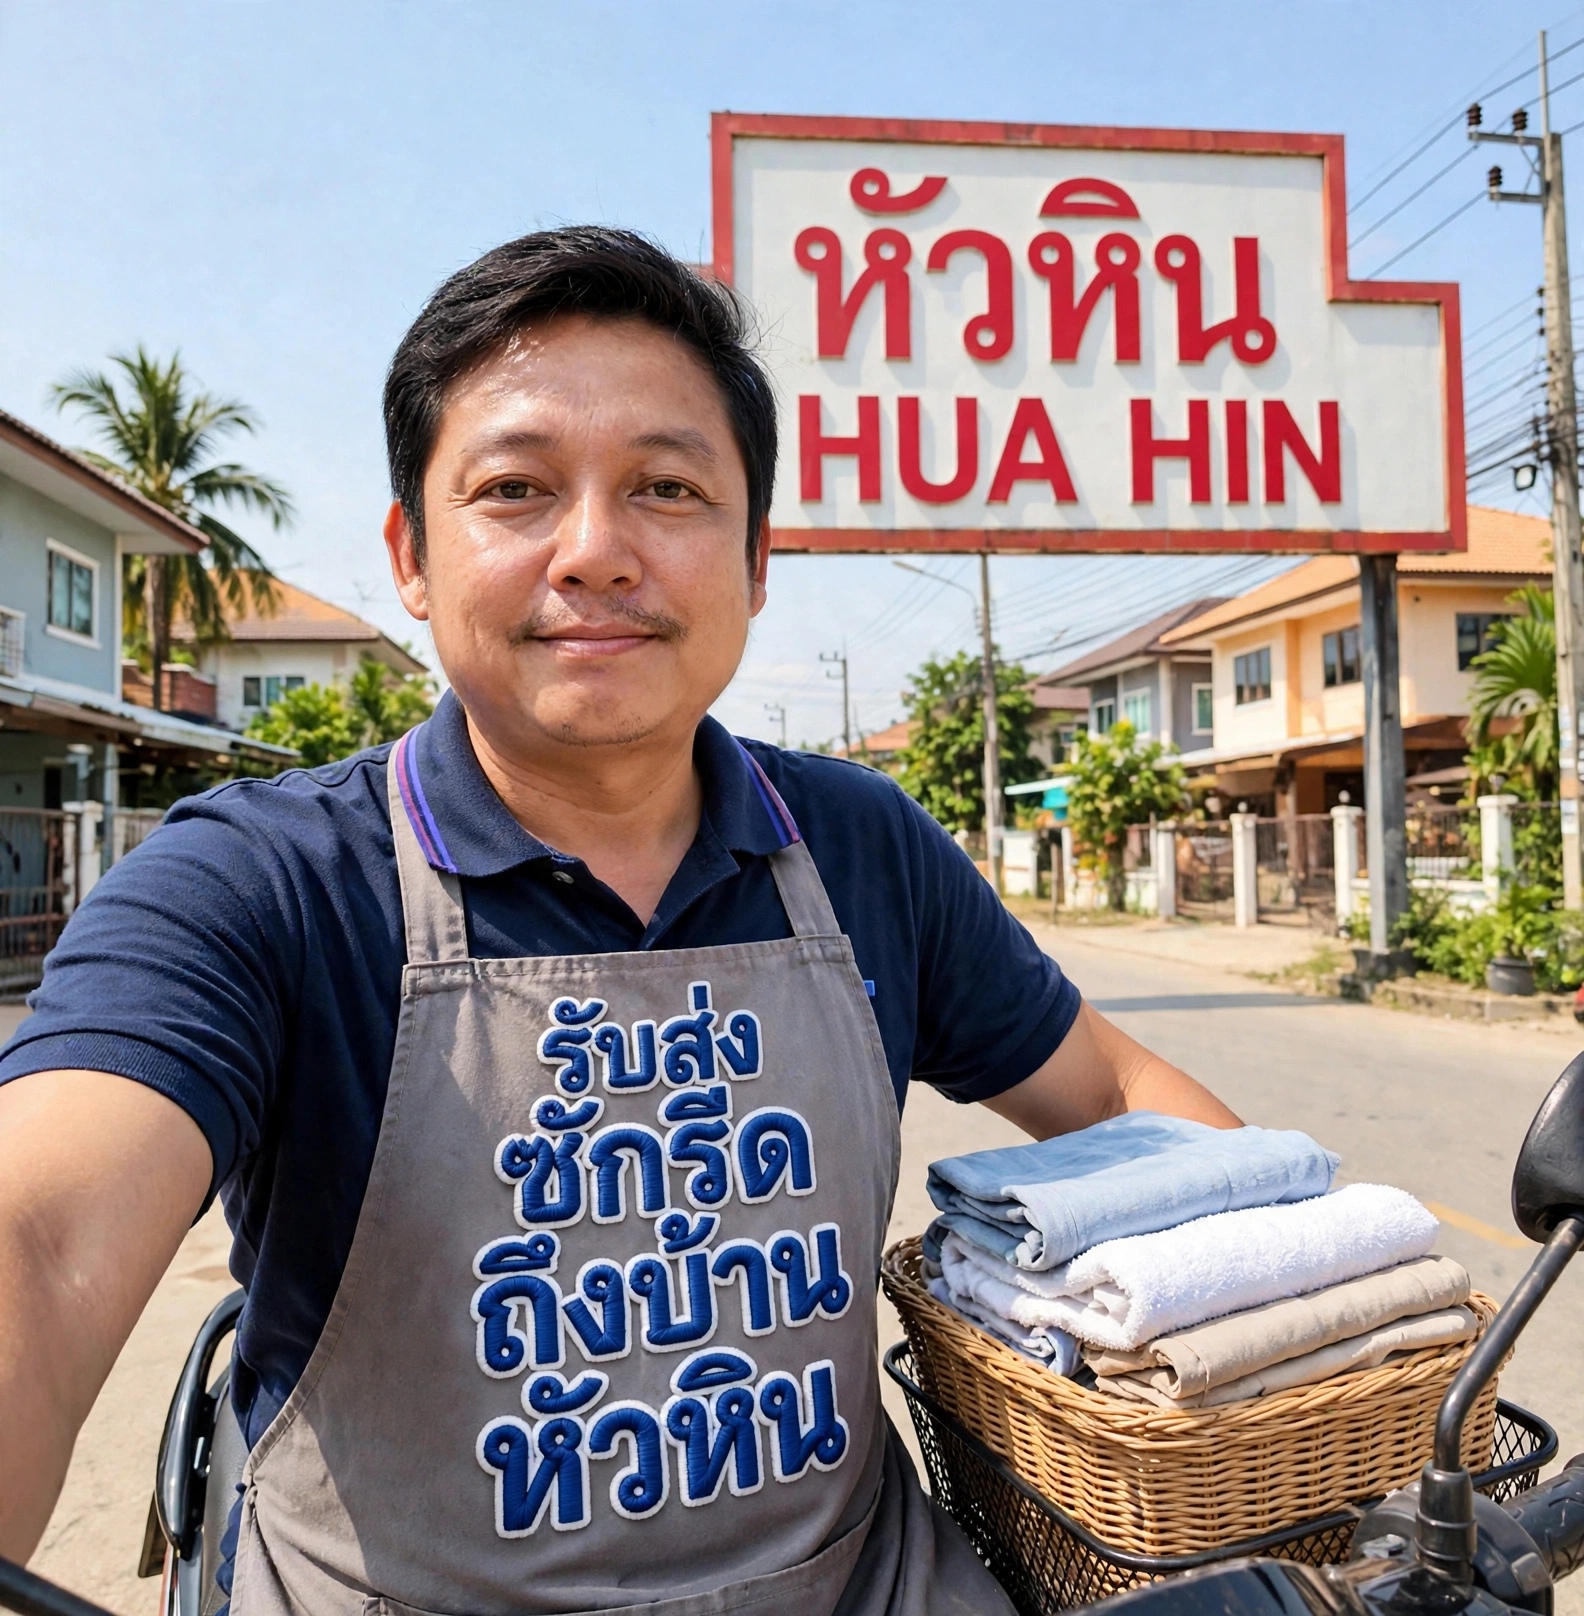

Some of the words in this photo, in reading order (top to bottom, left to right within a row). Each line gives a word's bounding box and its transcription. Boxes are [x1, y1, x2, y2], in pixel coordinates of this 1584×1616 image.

[794, 168, 1277, 365] หัวหิน
[798, 395, 1077, 505] HUA
[1130, 399, 1341, 503] HIN
[537, 981, 764, 1098] รับส่ง
[494, 1081, 817, 1229] ซักรีด
[470, 1208, 853, 1379] ถึงบ้าน
[476, 1347, 851, 1538] หัวหิน
